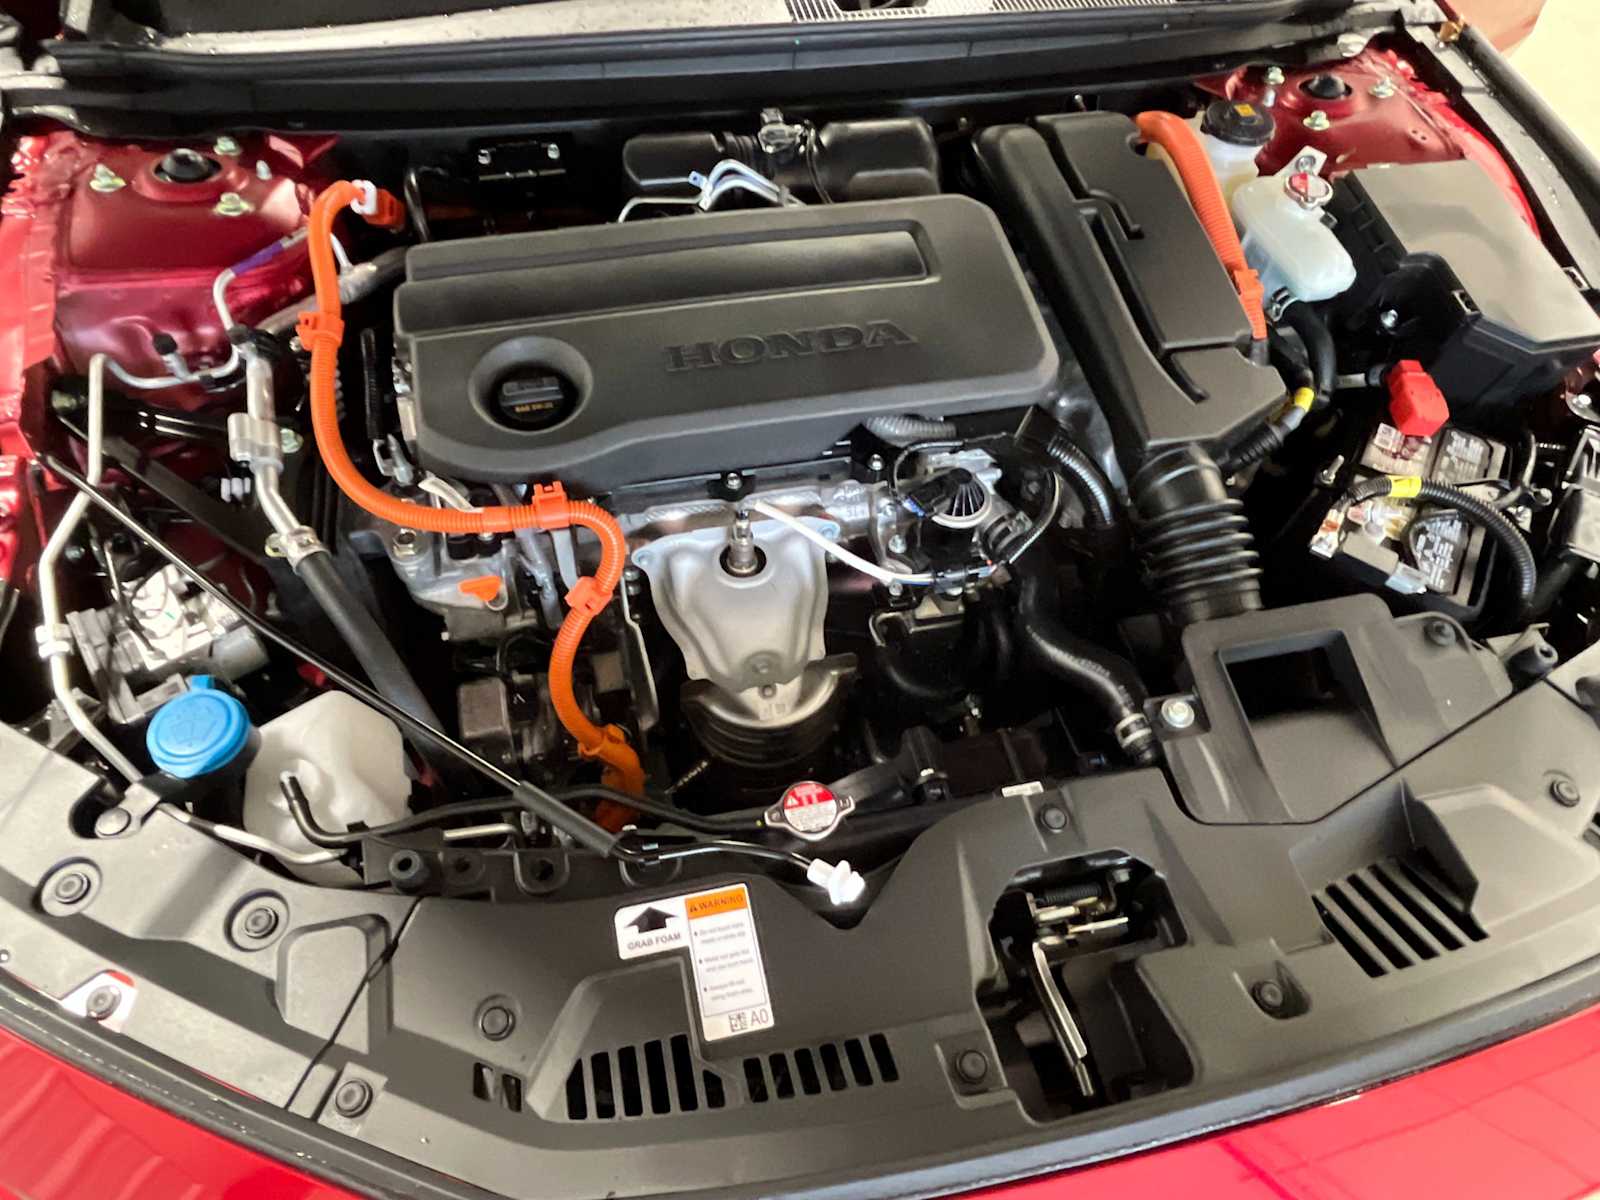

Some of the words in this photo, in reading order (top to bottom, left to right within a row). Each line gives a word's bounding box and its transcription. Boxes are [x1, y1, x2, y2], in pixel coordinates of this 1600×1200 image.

[664, 319, 919, 372] HONDA
[700, 894, 744, 911] WARNING
[627, 937, 654, 951] GRAB
[655, 932, 681, 946] FOAM
